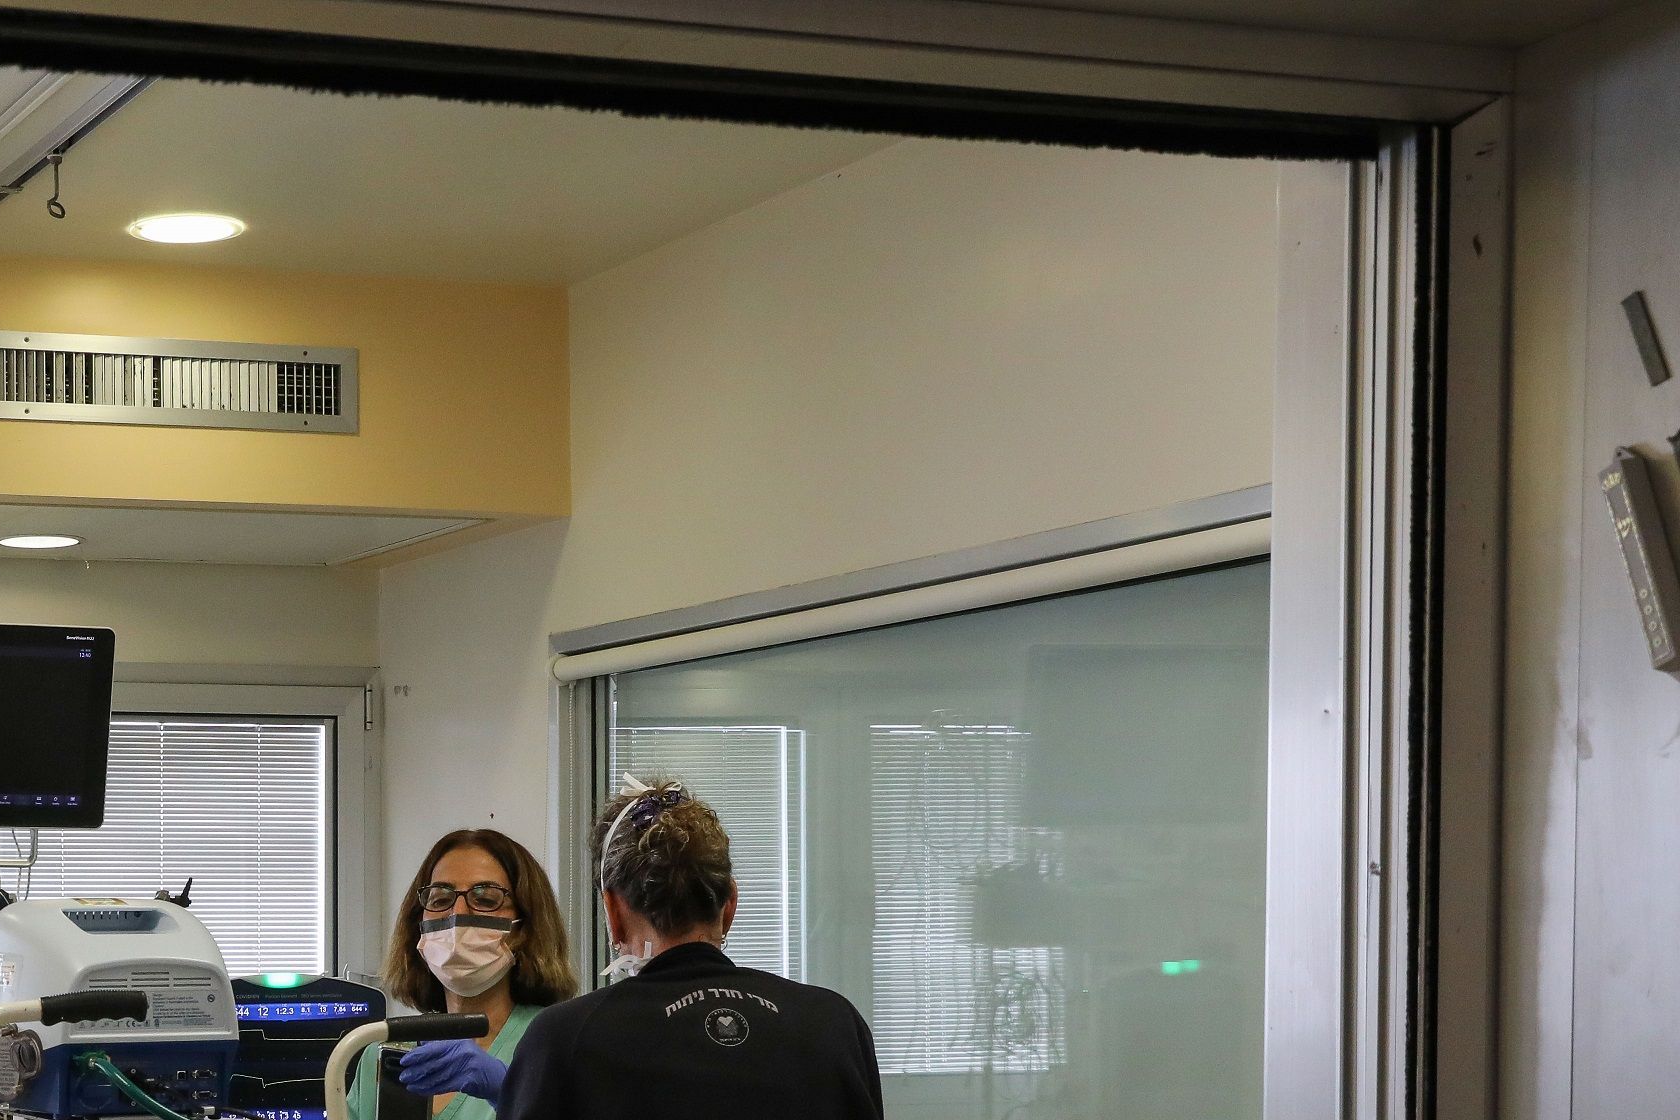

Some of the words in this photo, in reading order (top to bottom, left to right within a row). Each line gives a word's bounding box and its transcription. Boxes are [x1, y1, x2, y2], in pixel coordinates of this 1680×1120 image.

[707, 988, 744, 1000] חדר
[665, 990, 705, 1018] ניתוח
[258, 1007, 269, 1016] 12
[276, 1007, 294, 1015] 1:2.3
